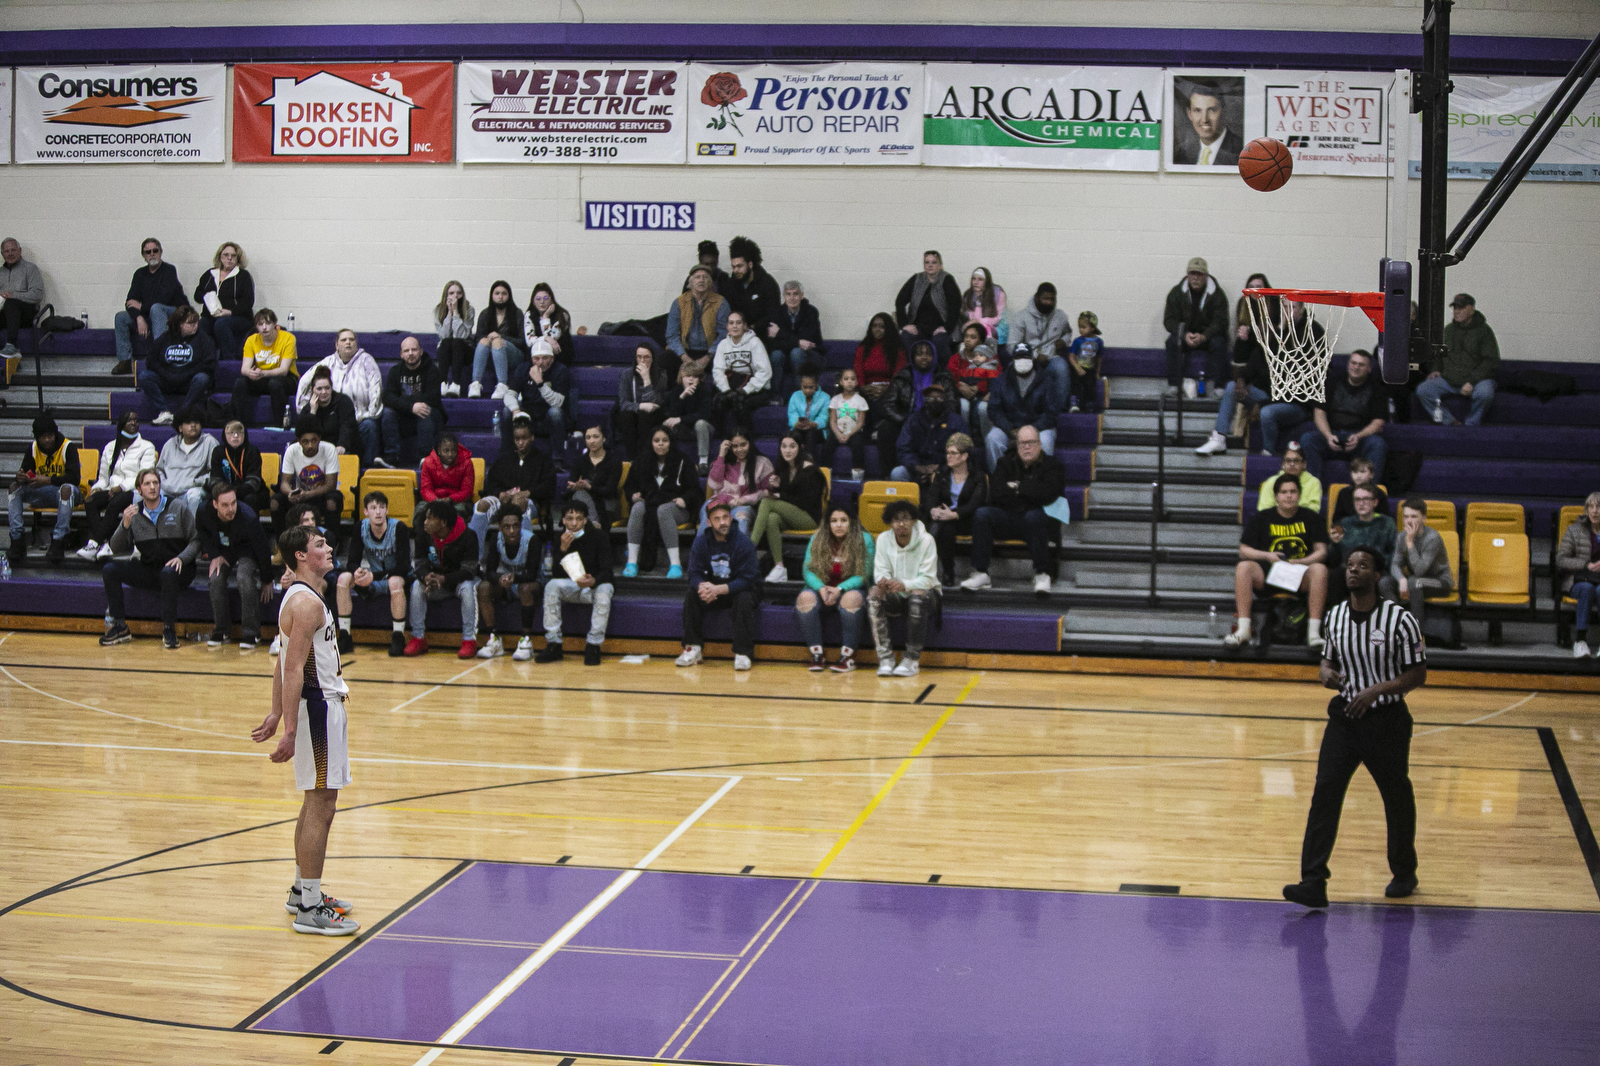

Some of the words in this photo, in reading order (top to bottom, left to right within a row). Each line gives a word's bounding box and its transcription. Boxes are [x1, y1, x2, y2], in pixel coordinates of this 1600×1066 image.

[38, 73, 198, 98] Consumers
[491, 69, 678, 96] WEBSTER
[828, 74, 863, 82] Personal
[865, 74, 889, 82] Touch
[747, 77, 911, 111] Persons
[1303, 80, 1345, 93] THE
[533, 96, 648, 115] ELECTRIC
[648, 105, 674, 116] INC.
[934, 85, 1158, 124] ARCADIA
[1274, 95, 1375, 119] WEST
[287, 102, 393, 123] DIRKSEN
[1418, 111, 1537, 128] Ispired
[478, 121, 535, 130] ELECTRICAL
[538, 122, 546, 130] &
[549, 122, 617, 130] NETWORKING
[619, 122, 665, 130] SERVICES
[755, 115, 814, 133] AUTO
[823, 115, 900, 133] REPAIR
[1041, 124, 1156, 139] CHEMICAL
[1275, 121, 1372, 134] AGENCY
[280, 127, 399, 147] ROOFING
[496, 135, 648, 144] www.websterelectric.com
[1476, 127, 1515, 137] Real
[36, 148, 201, 158] www.consumersconcrete.com
[413, 143, 434, 152] INC.
[523, 146, 618, 158] 269-388-3110
[744, 146, 771, 154] Proud
[772, 146, 815, 156] Supporter
[816, 146, 828, 155] Of
[828, 146, 843, 154] KC
[844, 146, 871, 156] Sports
[1296, 152, 1344, 163] Insurance
[589, 203, 692, 229] VISITORS
